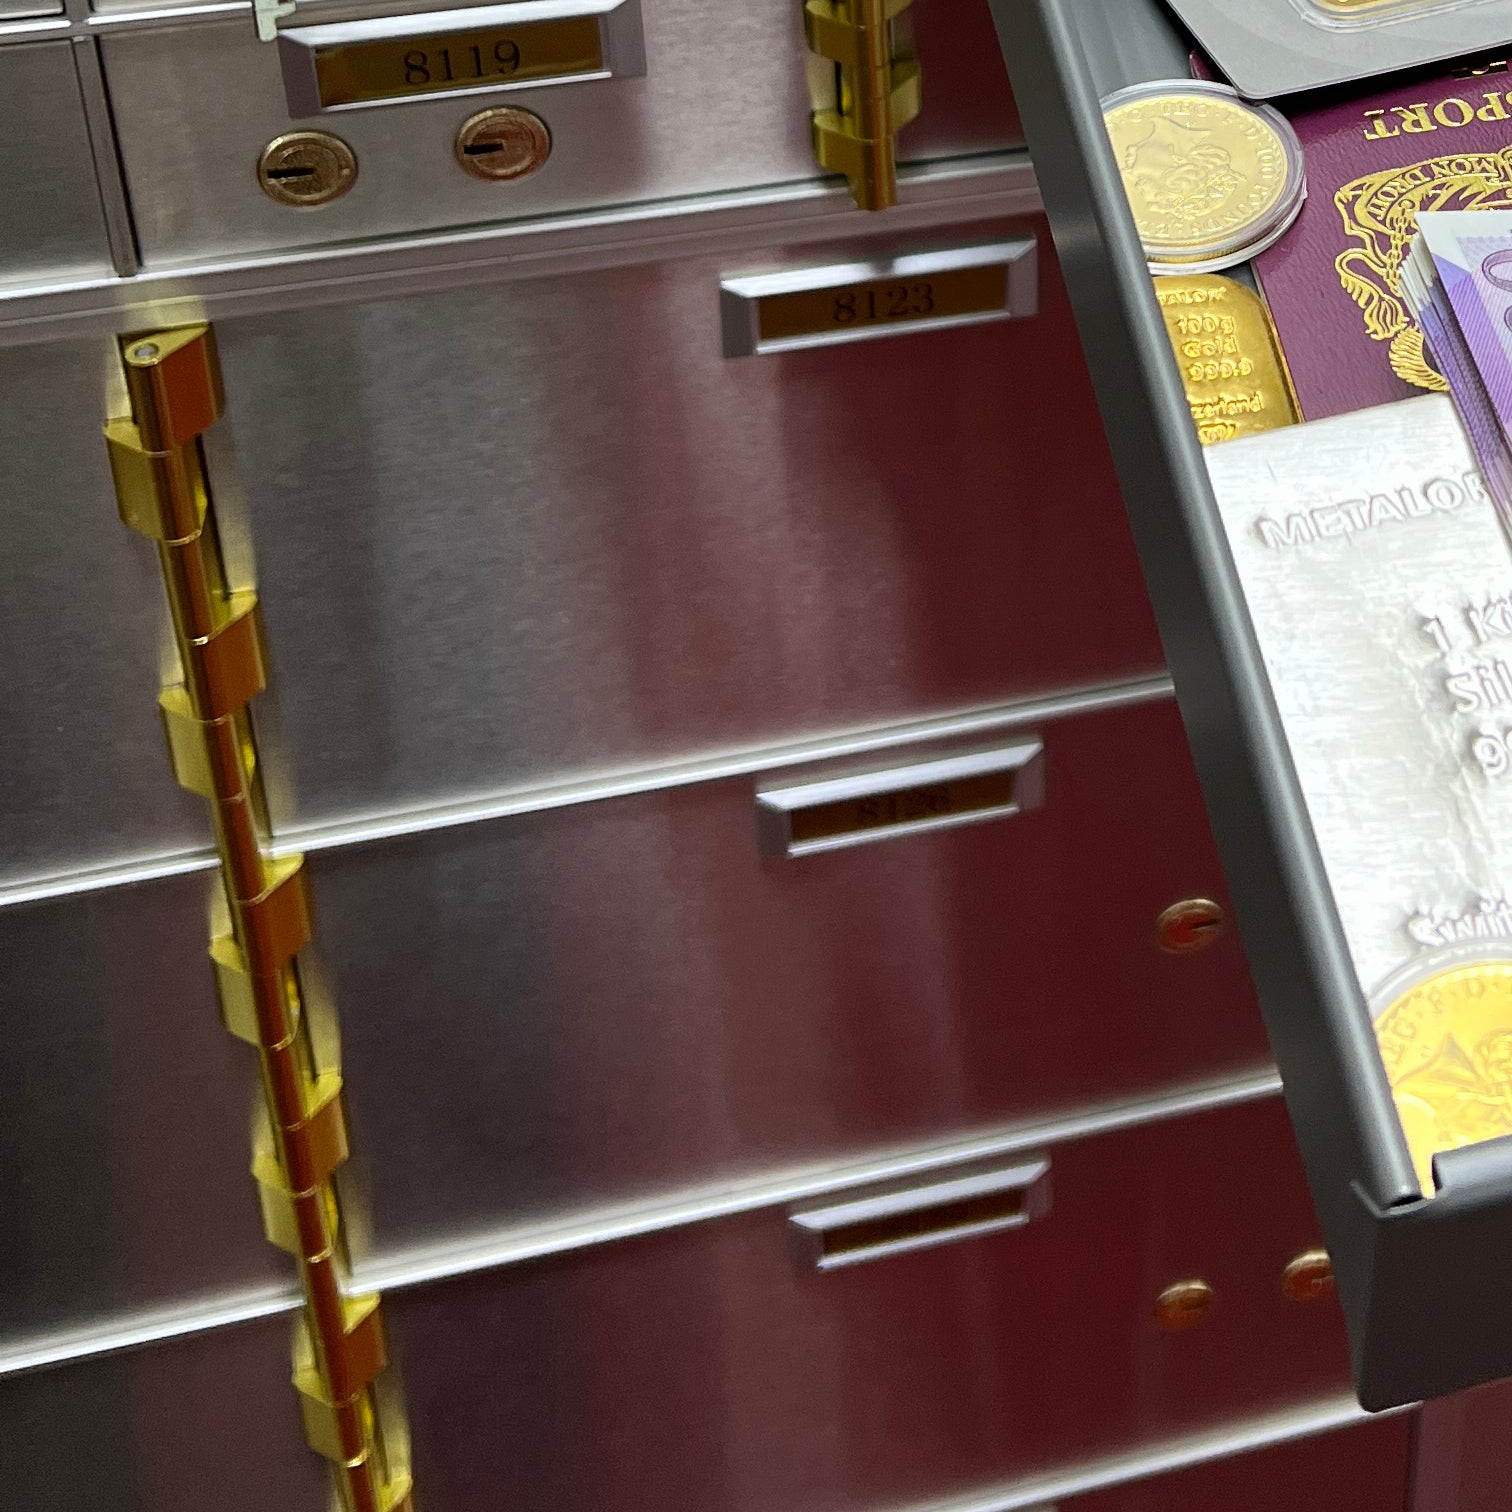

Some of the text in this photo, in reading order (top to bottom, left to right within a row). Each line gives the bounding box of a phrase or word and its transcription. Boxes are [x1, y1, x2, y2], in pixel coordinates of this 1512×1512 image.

[402, 38, 523, 87] 8119
[831, 283, 935, 325] 8123
[1181, 334, 1239, 358] Gold
[1421, 614, 1453, 656] 1
